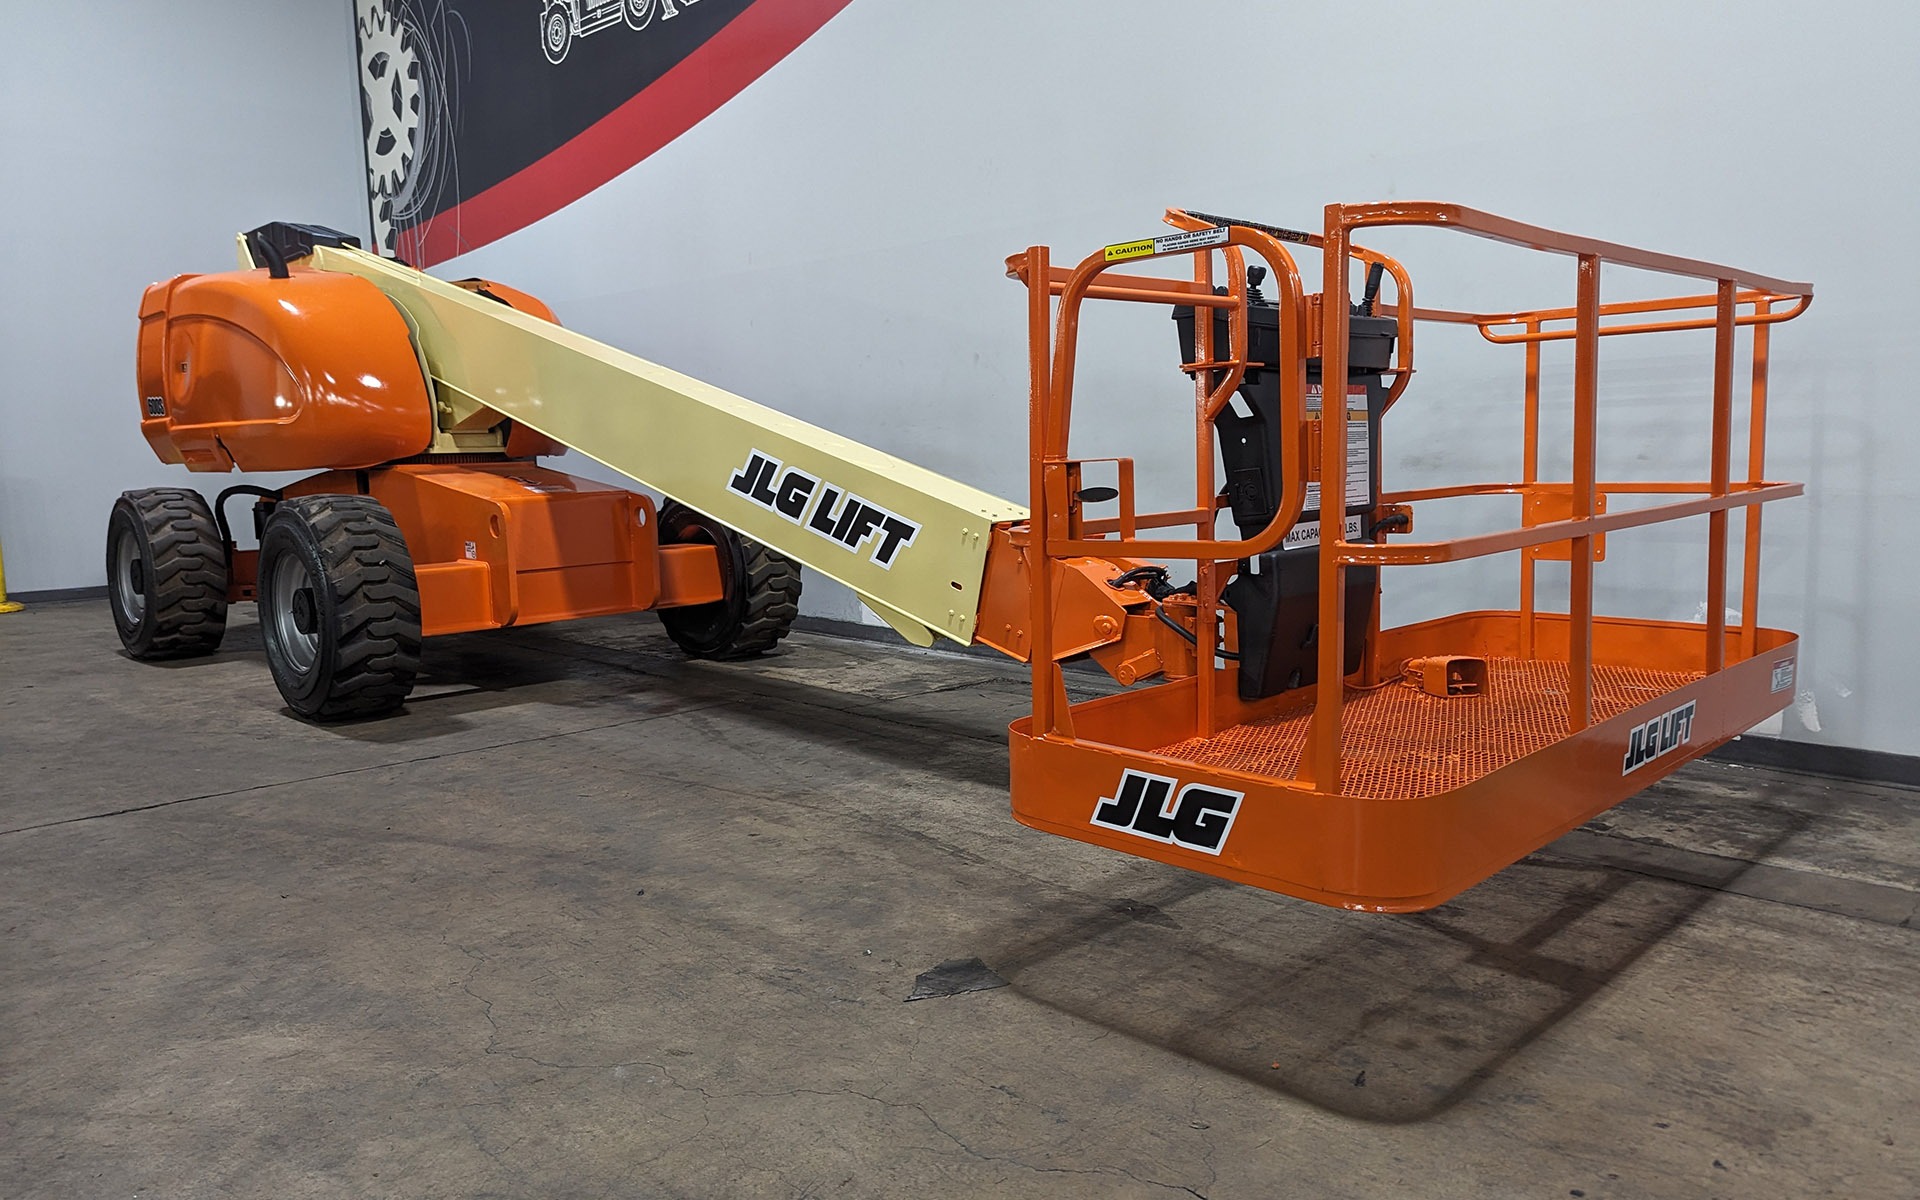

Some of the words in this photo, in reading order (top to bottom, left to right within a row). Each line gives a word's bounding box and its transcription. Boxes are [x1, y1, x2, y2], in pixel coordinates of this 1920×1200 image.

[1115, 244, 1153, 256] CAUTION
[147, 398, 165, 415] 600S
[731, 454, 816, 520] JLG
[809, 488, 915, 564] LIFT
[1285, 531, 1300, 543] MAX
[1301, 528, 1320, 540] CAPA
[1624, 720, 1660, 771] JLG
[1659, 704, 1695, 753] LIFT
[1095, 774, 1237, 850] JLG
